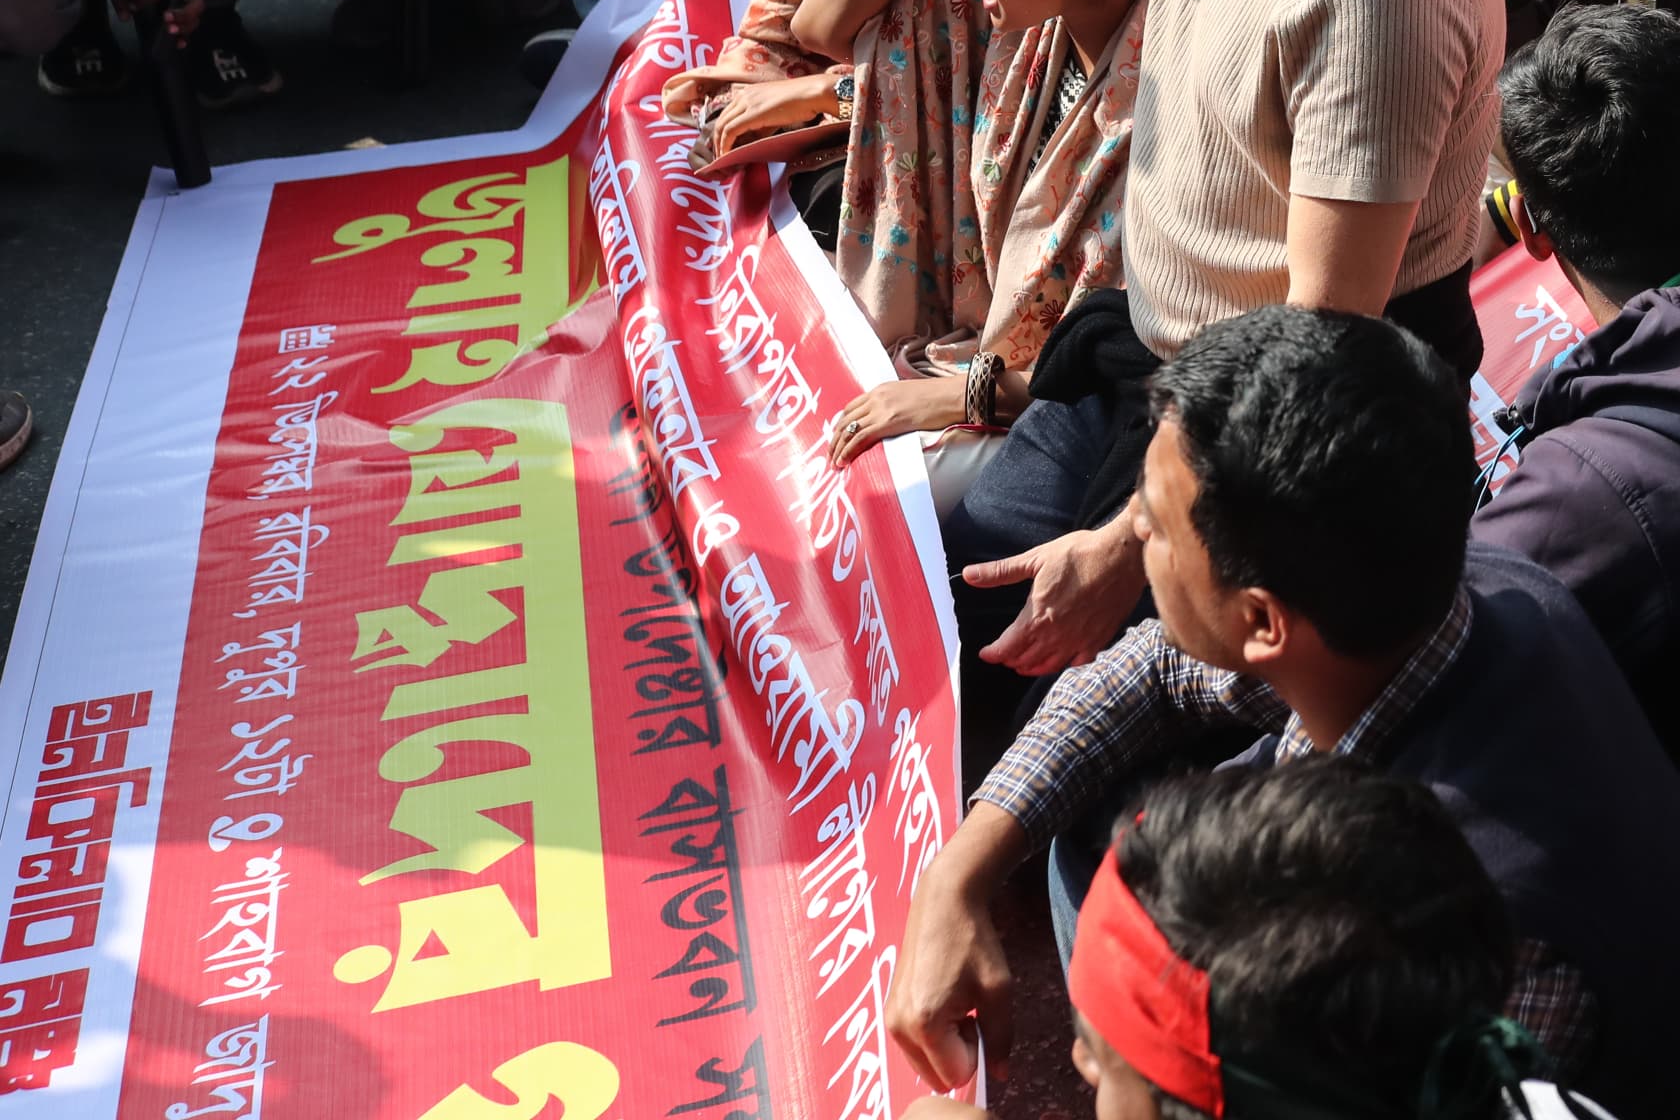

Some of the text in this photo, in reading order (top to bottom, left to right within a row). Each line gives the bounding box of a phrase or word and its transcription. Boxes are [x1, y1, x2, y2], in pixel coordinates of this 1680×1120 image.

[266, 355, 328, 397] ২২
[310, 155, 597, 398] জুলাই
[694, 244, 822, 448] নিরাপত্তা
[212, 621, 306, 703] দুপুর
[231, 505, 329, 618] রবিবার,
[216, 714, 312, 800] ১২টা
[331, 400, 612, 1013] যোদ্ধাদের
[692, 500, 739, 568] ও
[719, 553, 864, 815] আওয়ামী
[798, 772, 877, 999] লীগের
[0, 690, 153, 963] ইনকিলাব
[197, 847, 288, 1007] শাহবাগ
[636, 765, 757, 1027] বাসভবন
